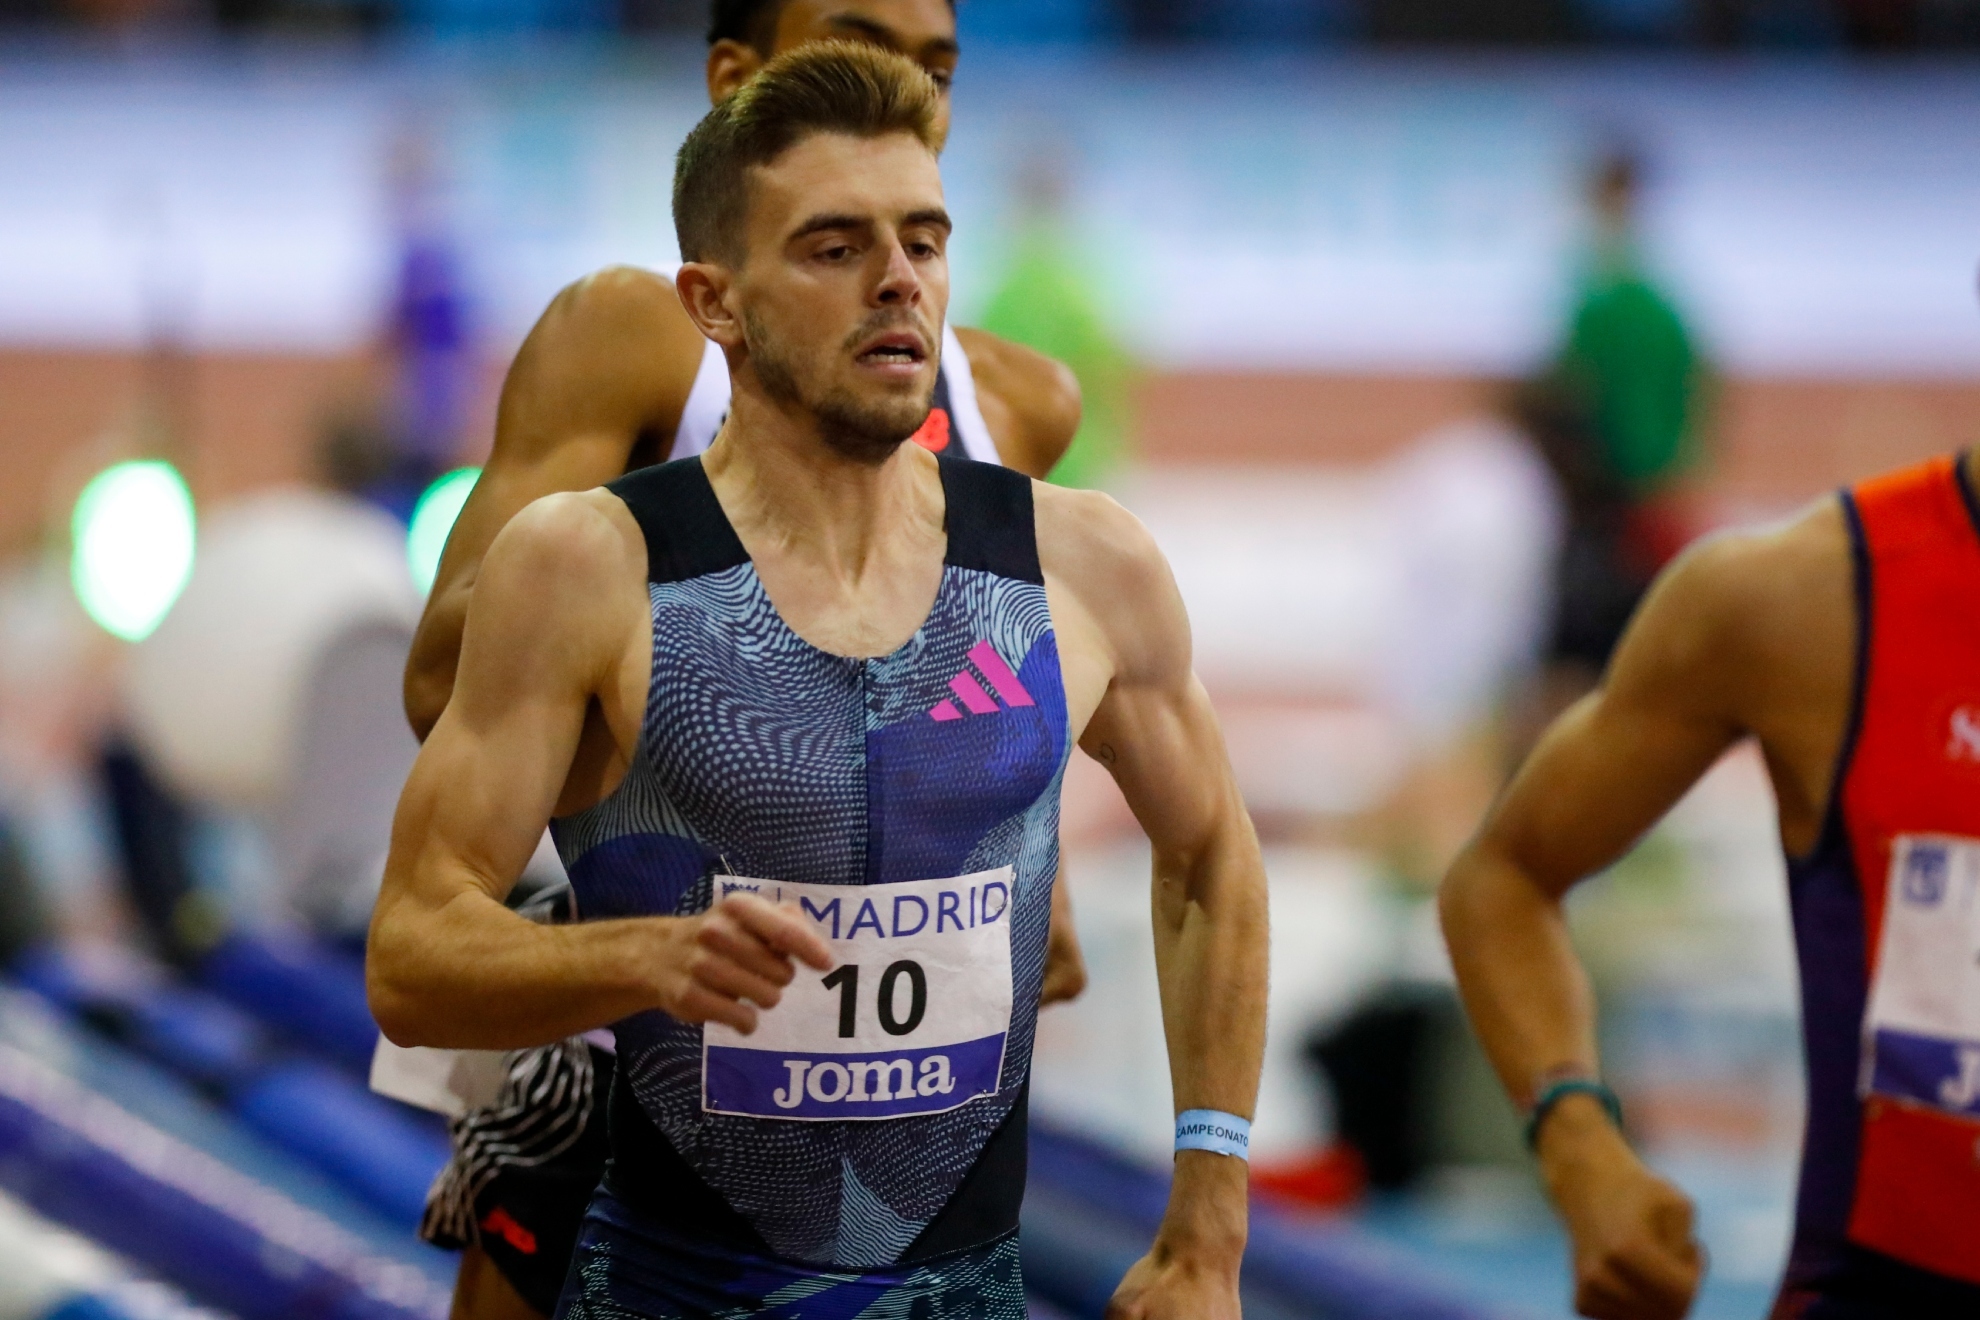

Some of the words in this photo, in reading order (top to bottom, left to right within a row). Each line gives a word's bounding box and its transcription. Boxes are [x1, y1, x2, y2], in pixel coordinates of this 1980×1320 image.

[801, 881, 1008, 940] MADRID
[820, 959, 928, 1039] 10
[773, 1054, 957, 1109] Joma
[1176, 1123, 1249, 1148] CAMPEONATO
